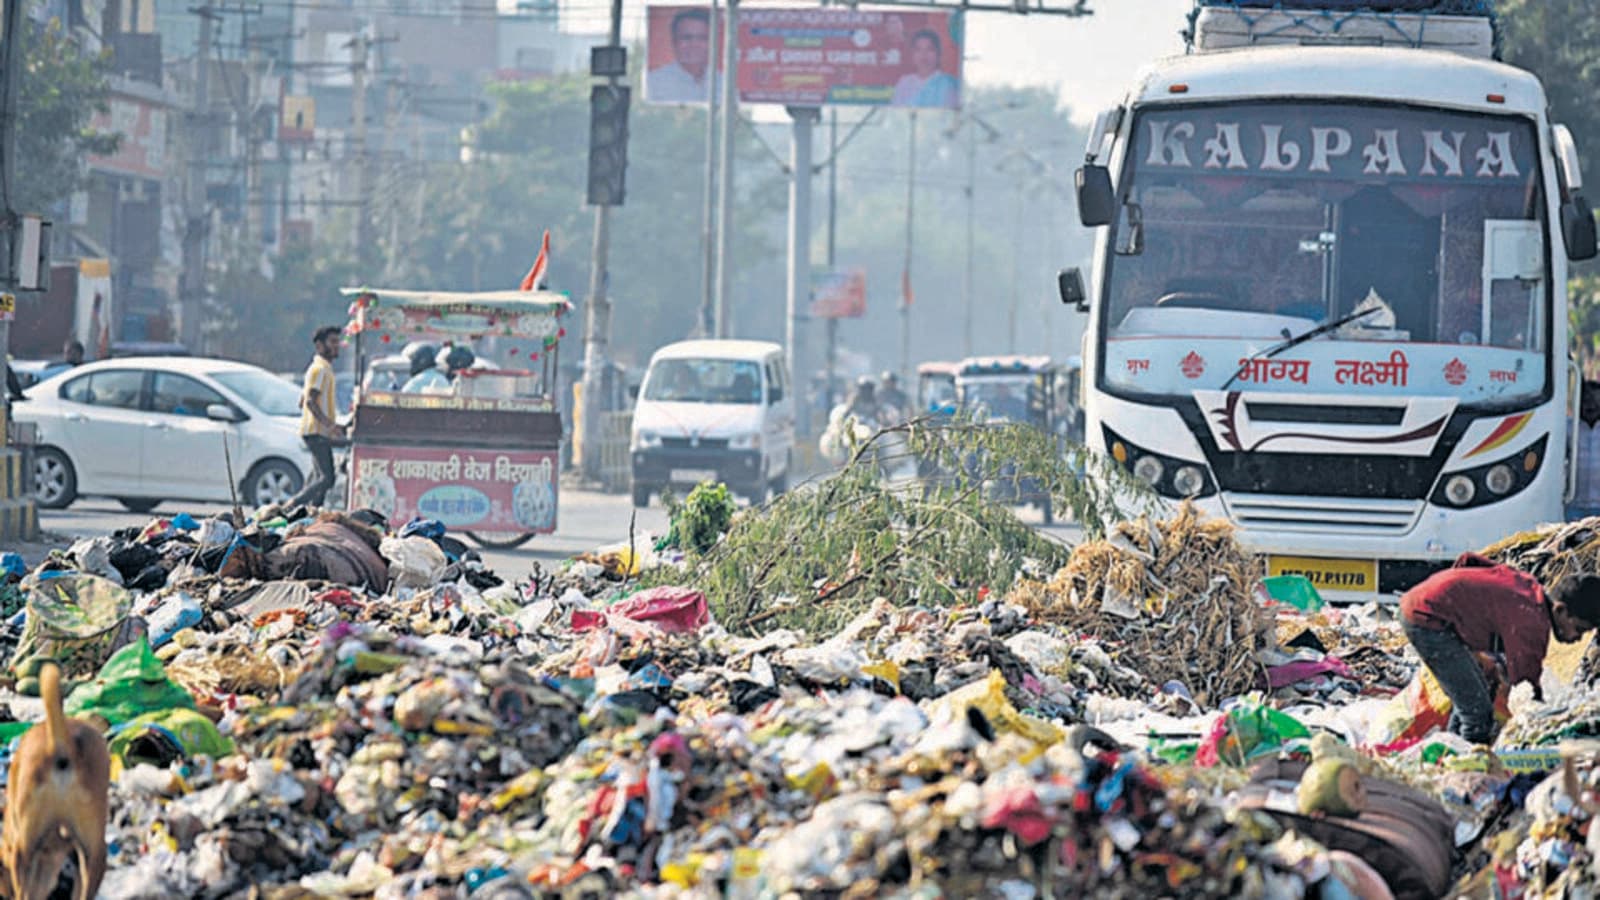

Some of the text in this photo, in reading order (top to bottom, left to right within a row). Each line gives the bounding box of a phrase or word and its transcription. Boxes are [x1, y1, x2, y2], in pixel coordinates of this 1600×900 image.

[1145, 120, 1521, 177] KALPANA
[1126, 359, 1149, 375] शुभ
[1237, 349, 1410, 386] भाग्य लक्ष्मी
[1489, 369, 1517, 383] लाभ
[393, 454, 460, 482] शाकाहारी
[465, 456, 491, 480] वेज
